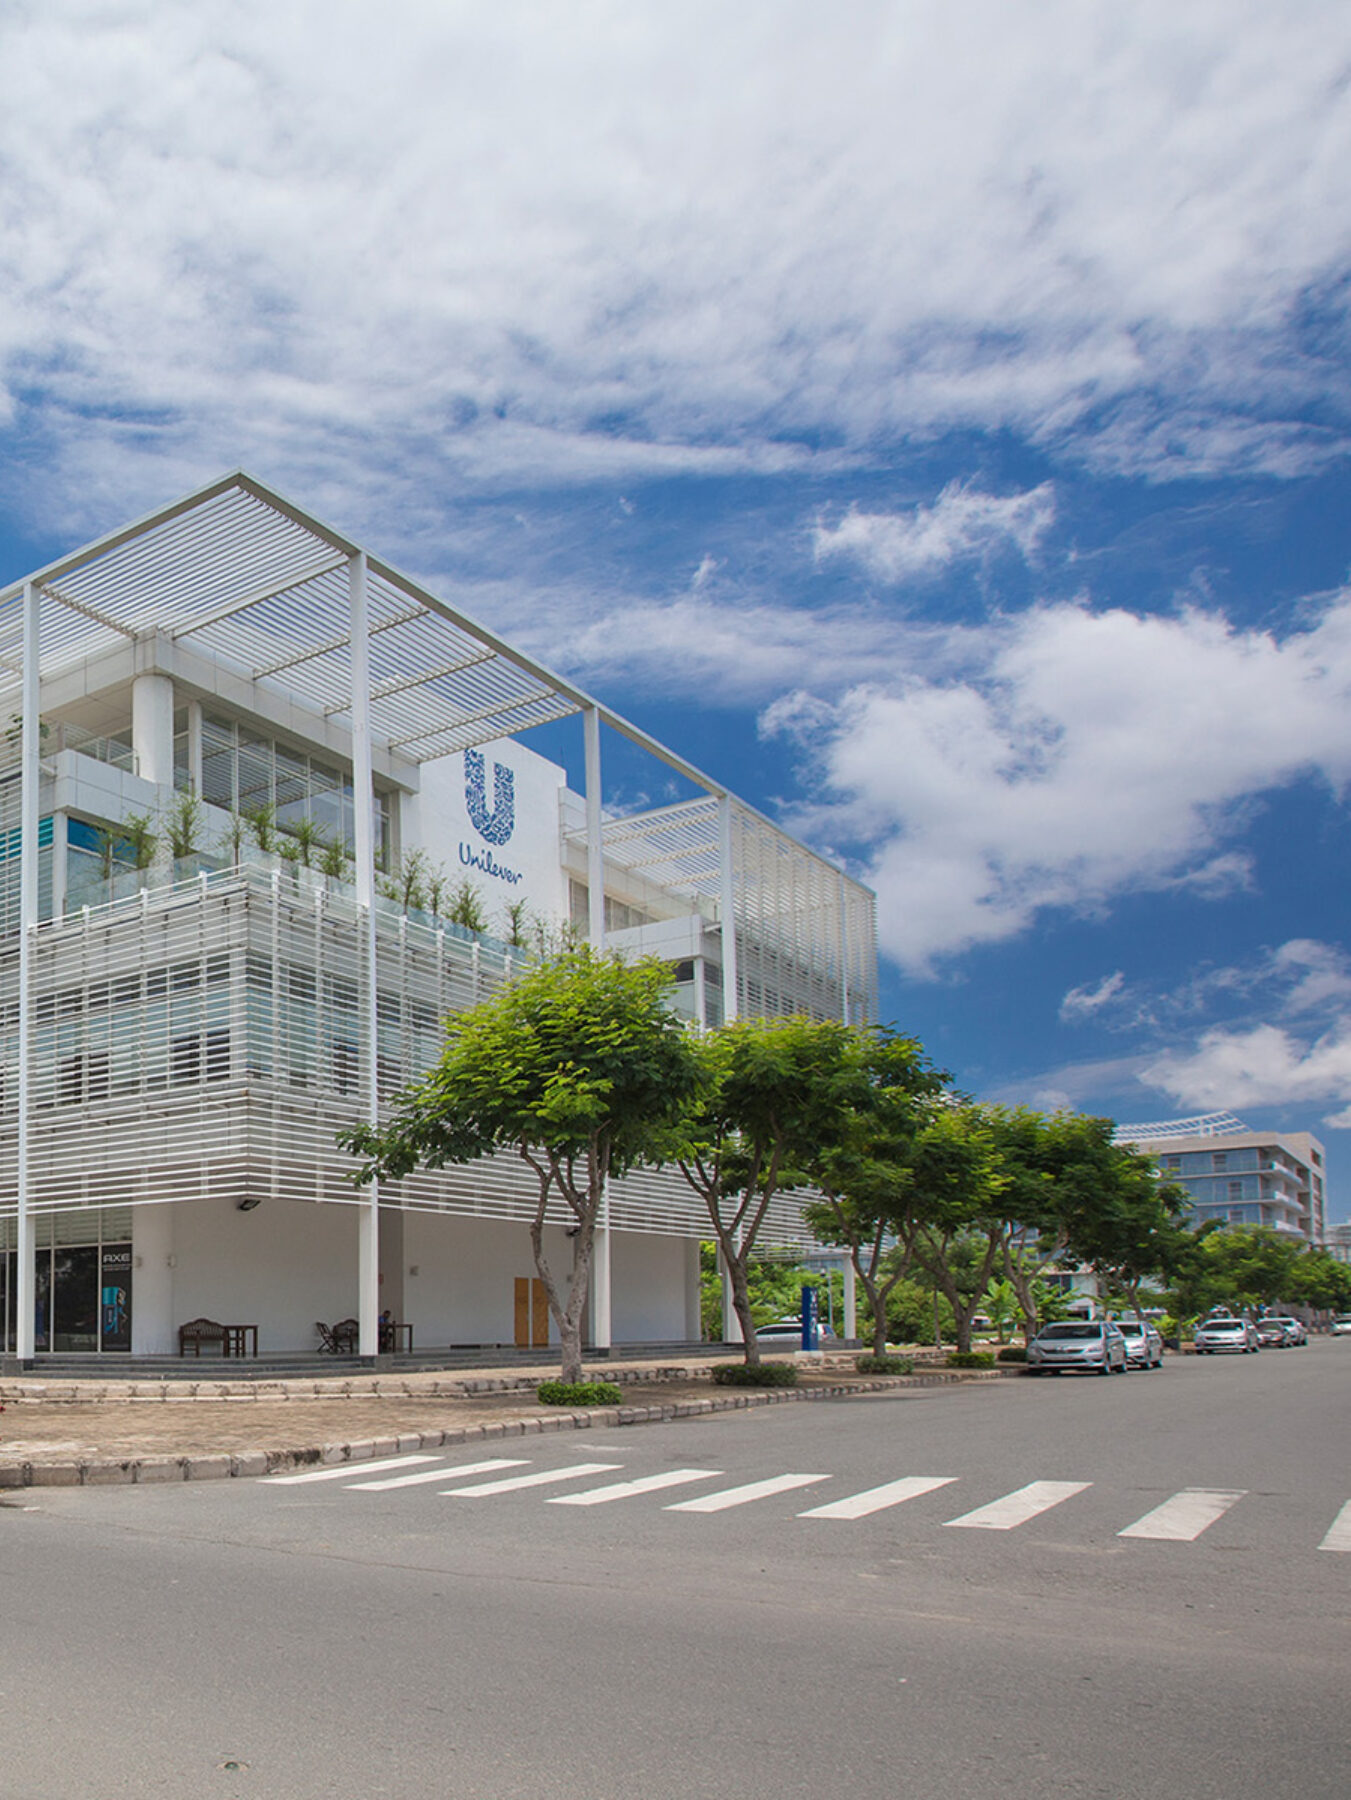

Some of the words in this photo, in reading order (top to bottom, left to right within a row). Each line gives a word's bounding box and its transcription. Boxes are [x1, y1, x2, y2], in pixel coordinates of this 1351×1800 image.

[464, 748, 515, 846] U
[459, 842, 523, 885] Unilever
[103, 1253, 130, 1264] AXE
